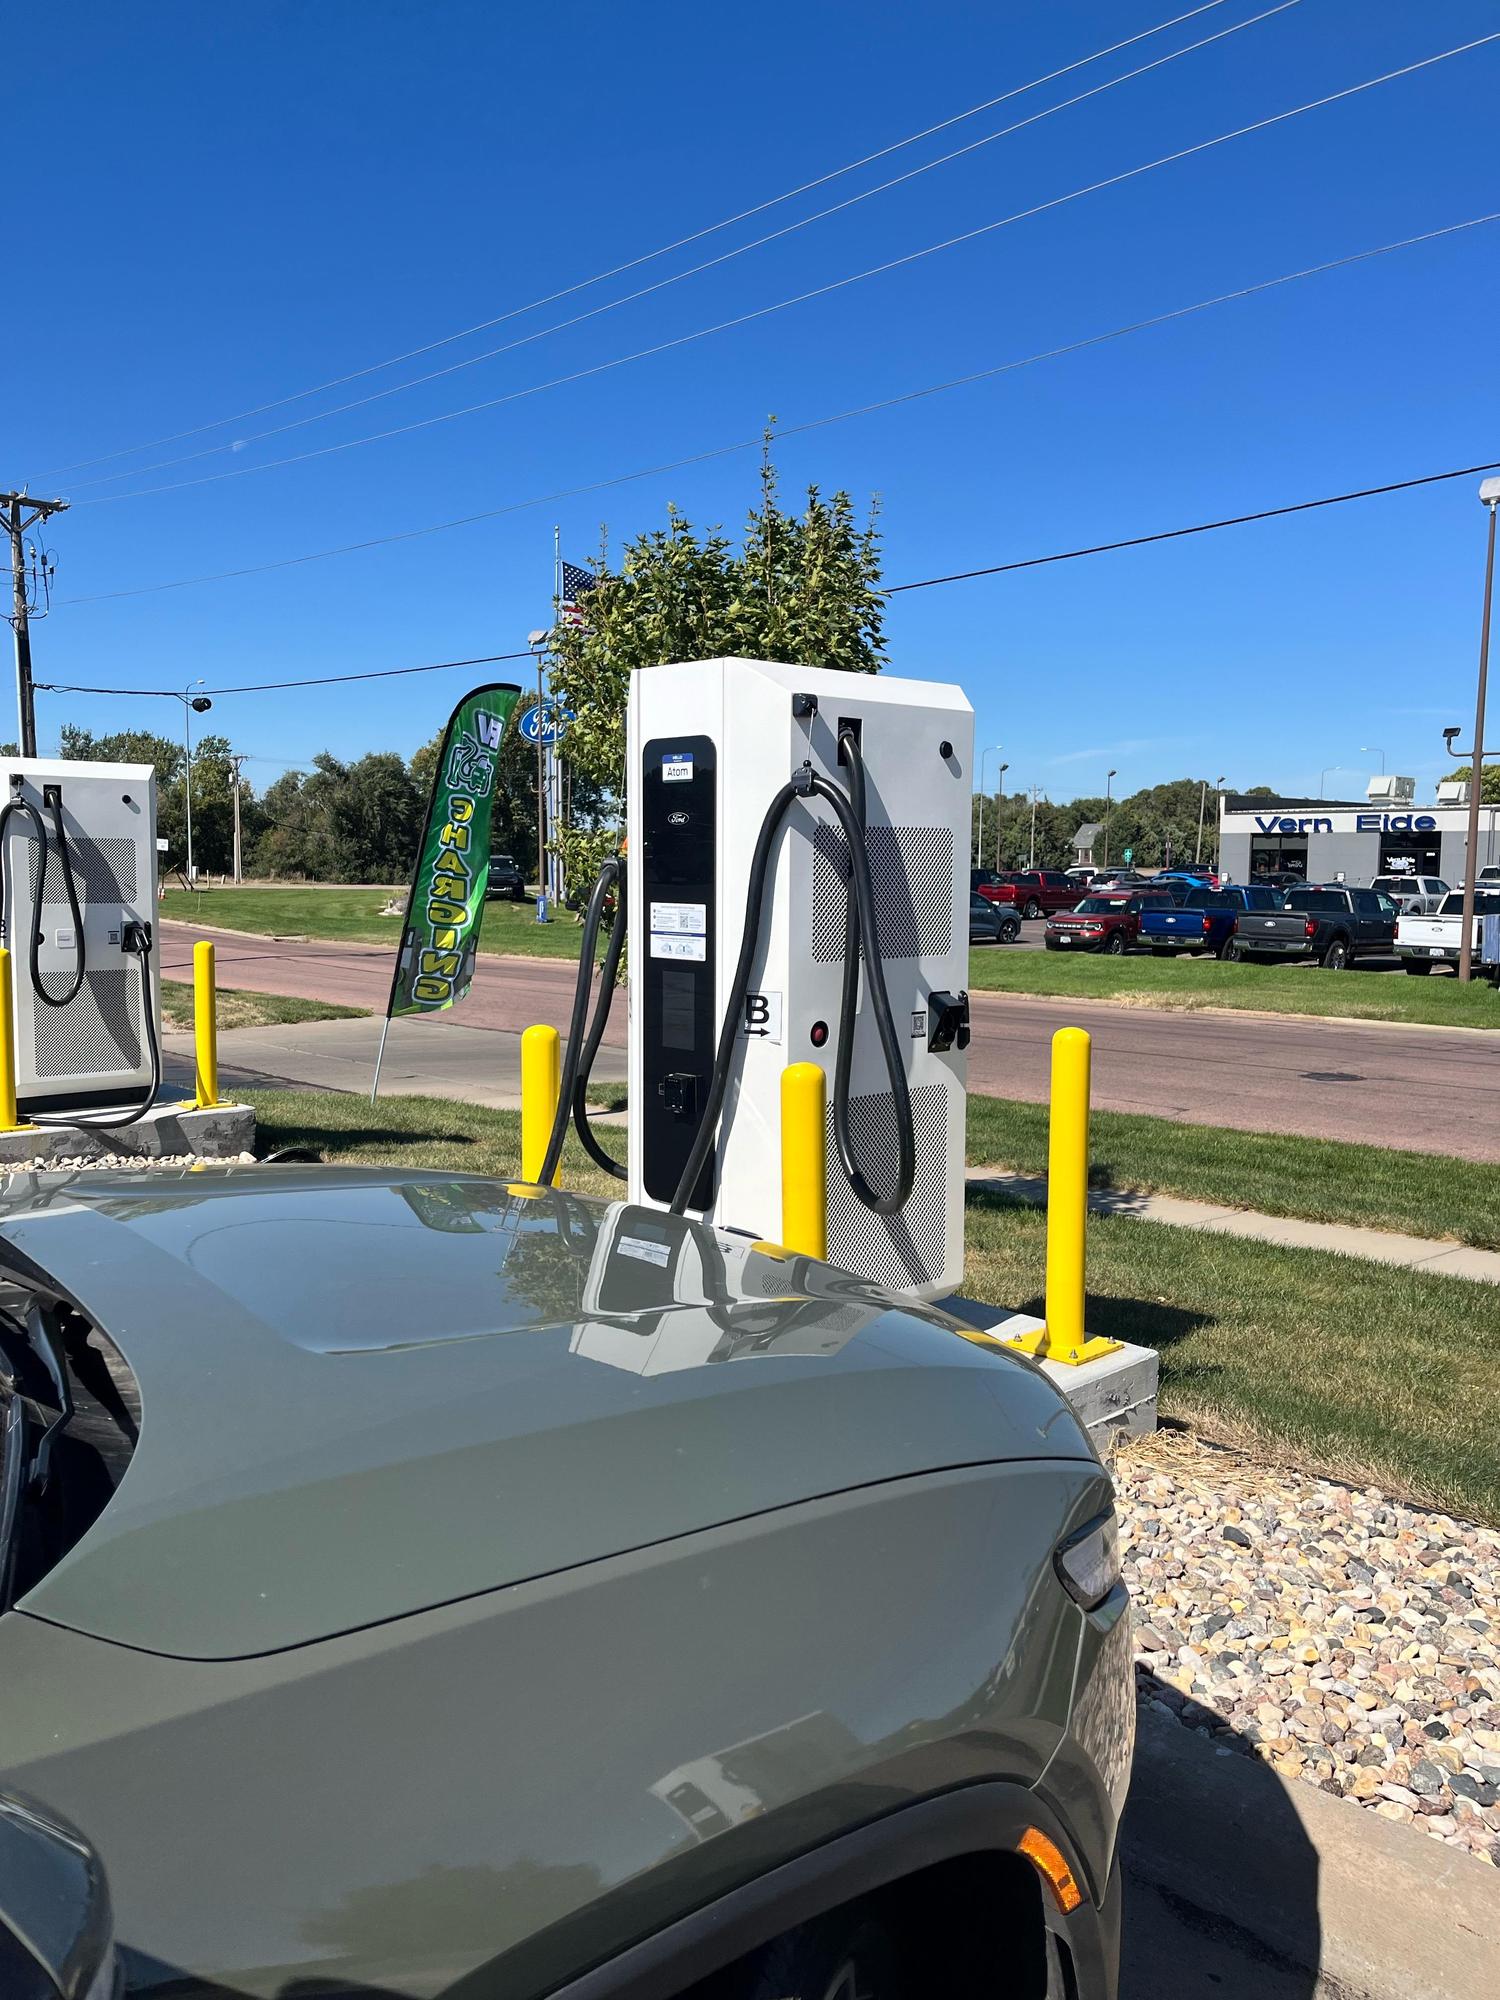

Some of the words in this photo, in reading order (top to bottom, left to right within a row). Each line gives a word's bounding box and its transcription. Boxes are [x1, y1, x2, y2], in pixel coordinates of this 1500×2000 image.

[667, 766, 689, 777] Atom
[1255, 815, 1333, 834] Vern
[1356, 814, 1437, 833] Eide
[746, 995, 770, 1024] B
